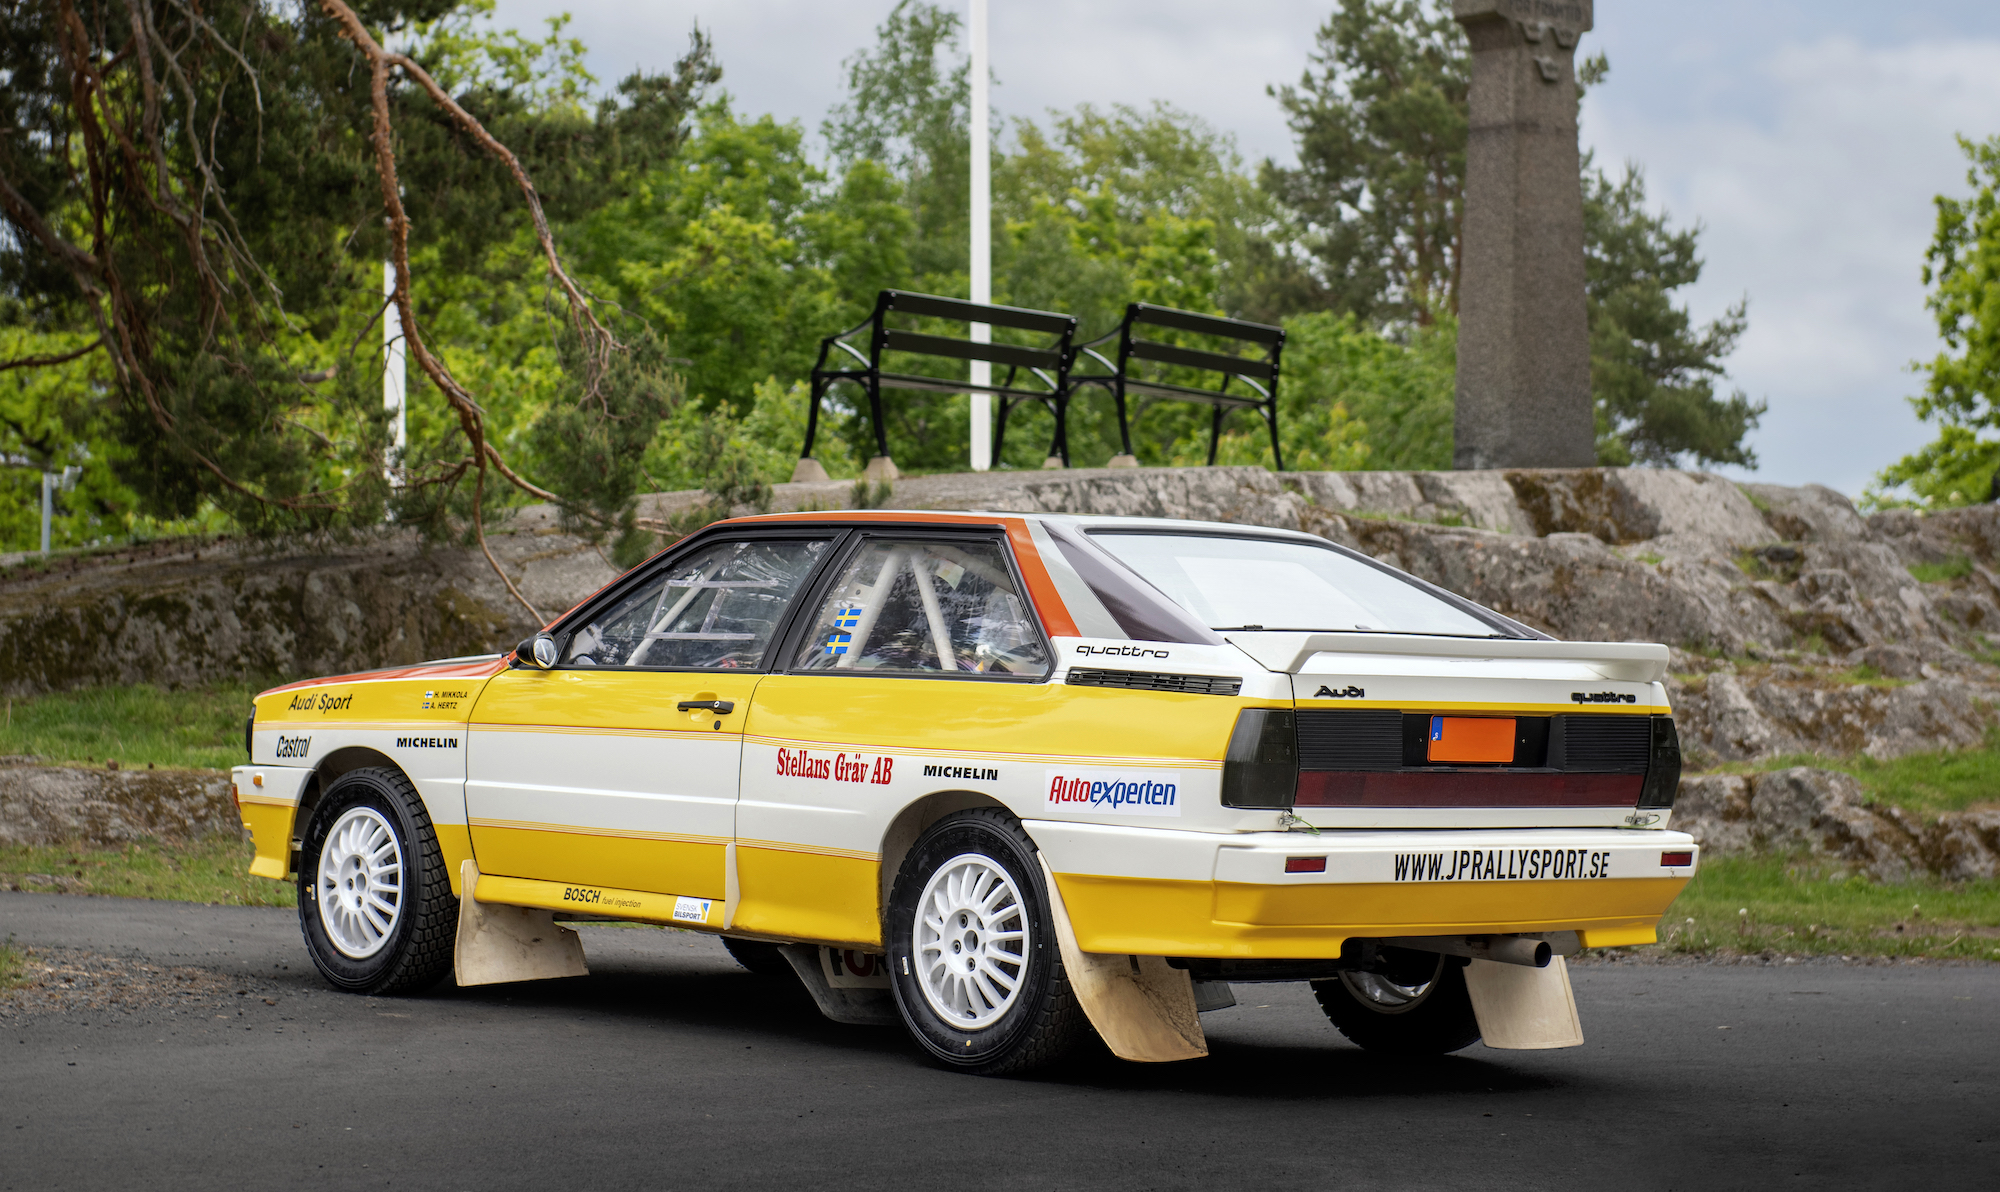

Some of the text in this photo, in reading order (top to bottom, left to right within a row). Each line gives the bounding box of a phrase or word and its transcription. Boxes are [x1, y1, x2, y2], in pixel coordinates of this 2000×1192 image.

[1075, 645, 1170, 659] quattro
[433, 690, 468, 699] H. MIKKOLA
[1313, 685, 1365, 698] Audi
[1570, 691, 1636, 705] quattro
[288, 693, 353, 715] Audi Sport
[429, 701, 458, 710] A. HERTZ
[276, 735, 312, 758] Castrol
[396, 737, 458, 748] MICHELIN
[776, 747, 894, 786] Stellans Gräv AB
[923, 764, 999, 781] MICHELIN
[1048, 775, 1177, 810] Autoexperten
[1394, 849, 1611, 882] WWW.JPRALLYSPORT.SE
[563, 887, 642, 909] BOSCH fuel injection
[676, 903, 698, 912] SVENSK
[674, 910, 701, 920] BILSPORT
